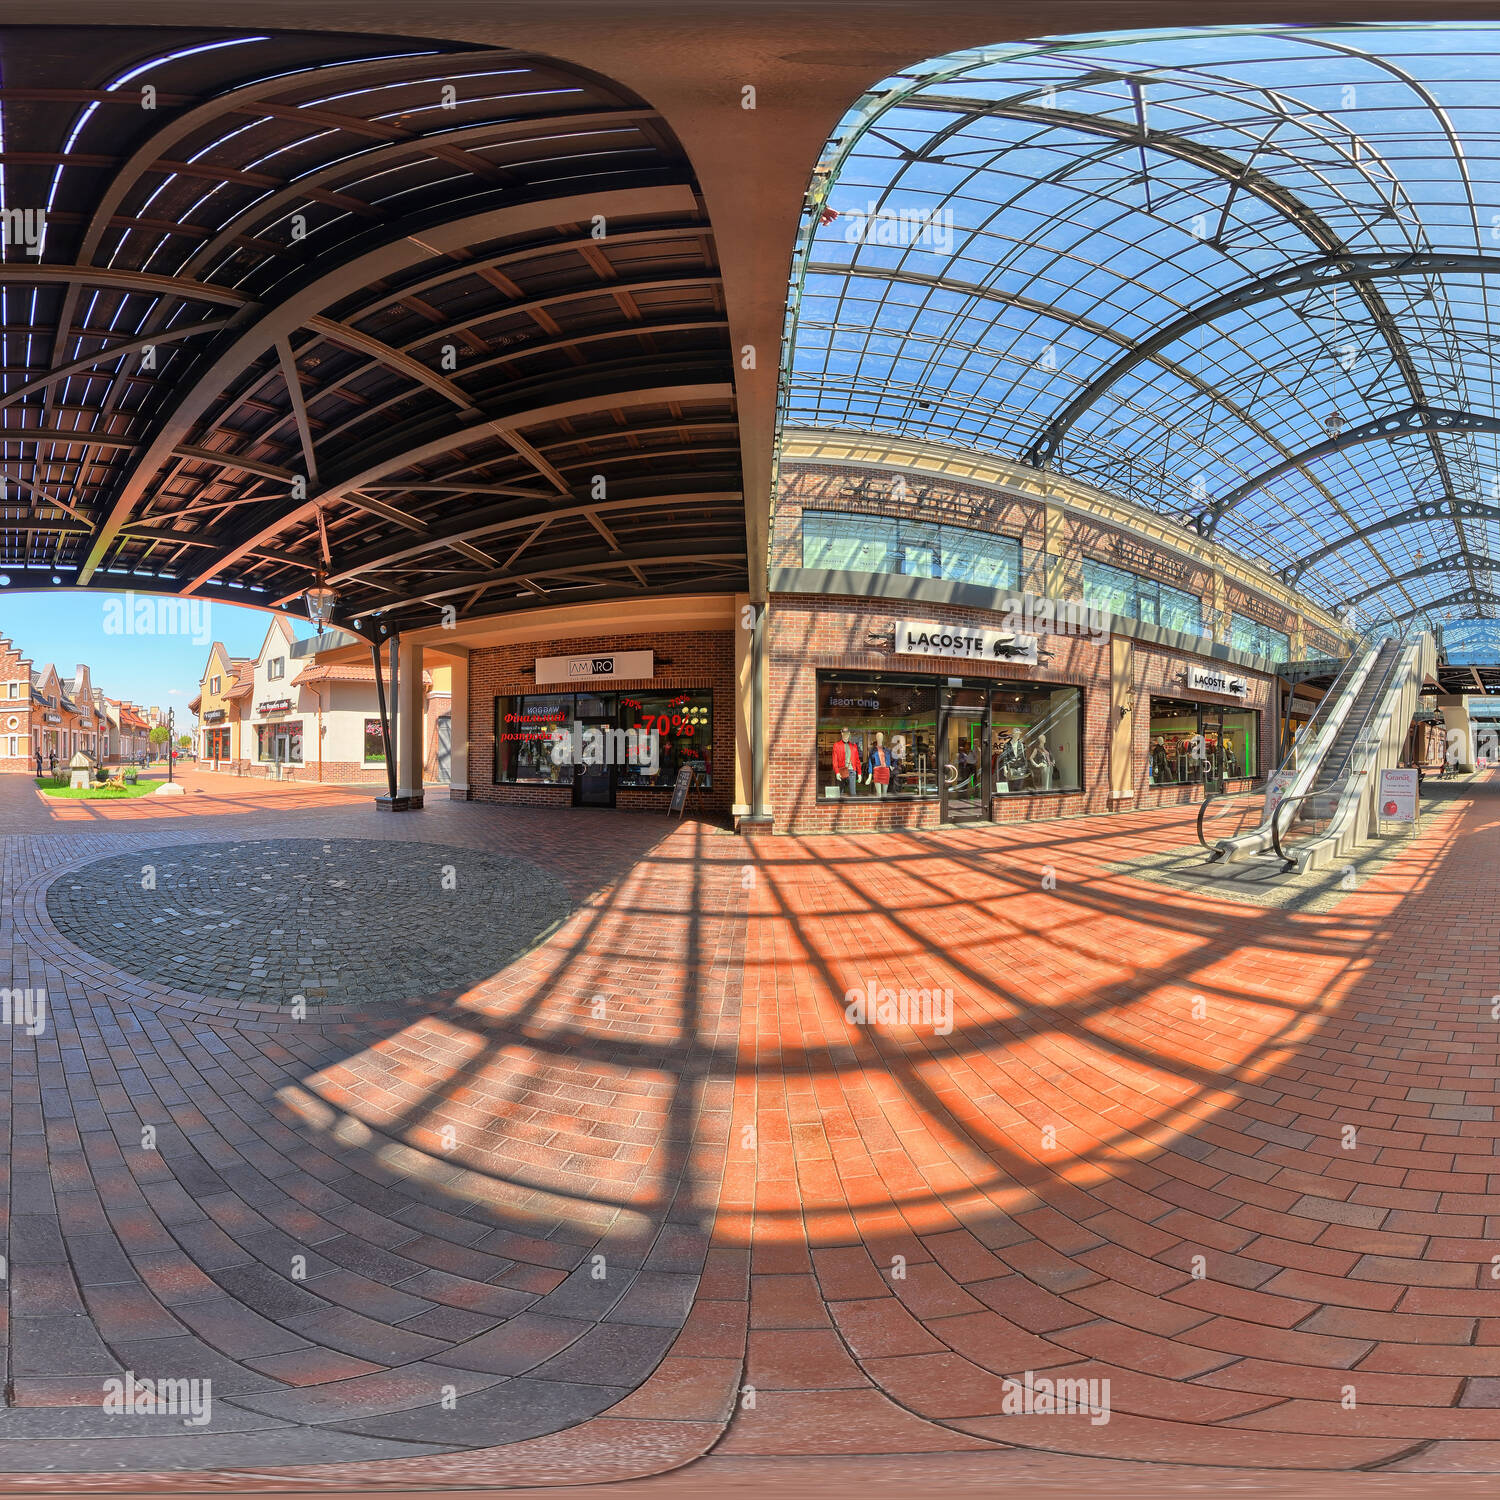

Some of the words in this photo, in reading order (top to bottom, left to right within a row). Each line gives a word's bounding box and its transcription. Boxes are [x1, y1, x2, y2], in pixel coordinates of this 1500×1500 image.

[907, 631, 983, 651] LACOSTE
[571, 660, 613, 673] AMARO
[1195, 674, 1225, 688] LACOSTE
[633, 714, 695, 737] -70%
